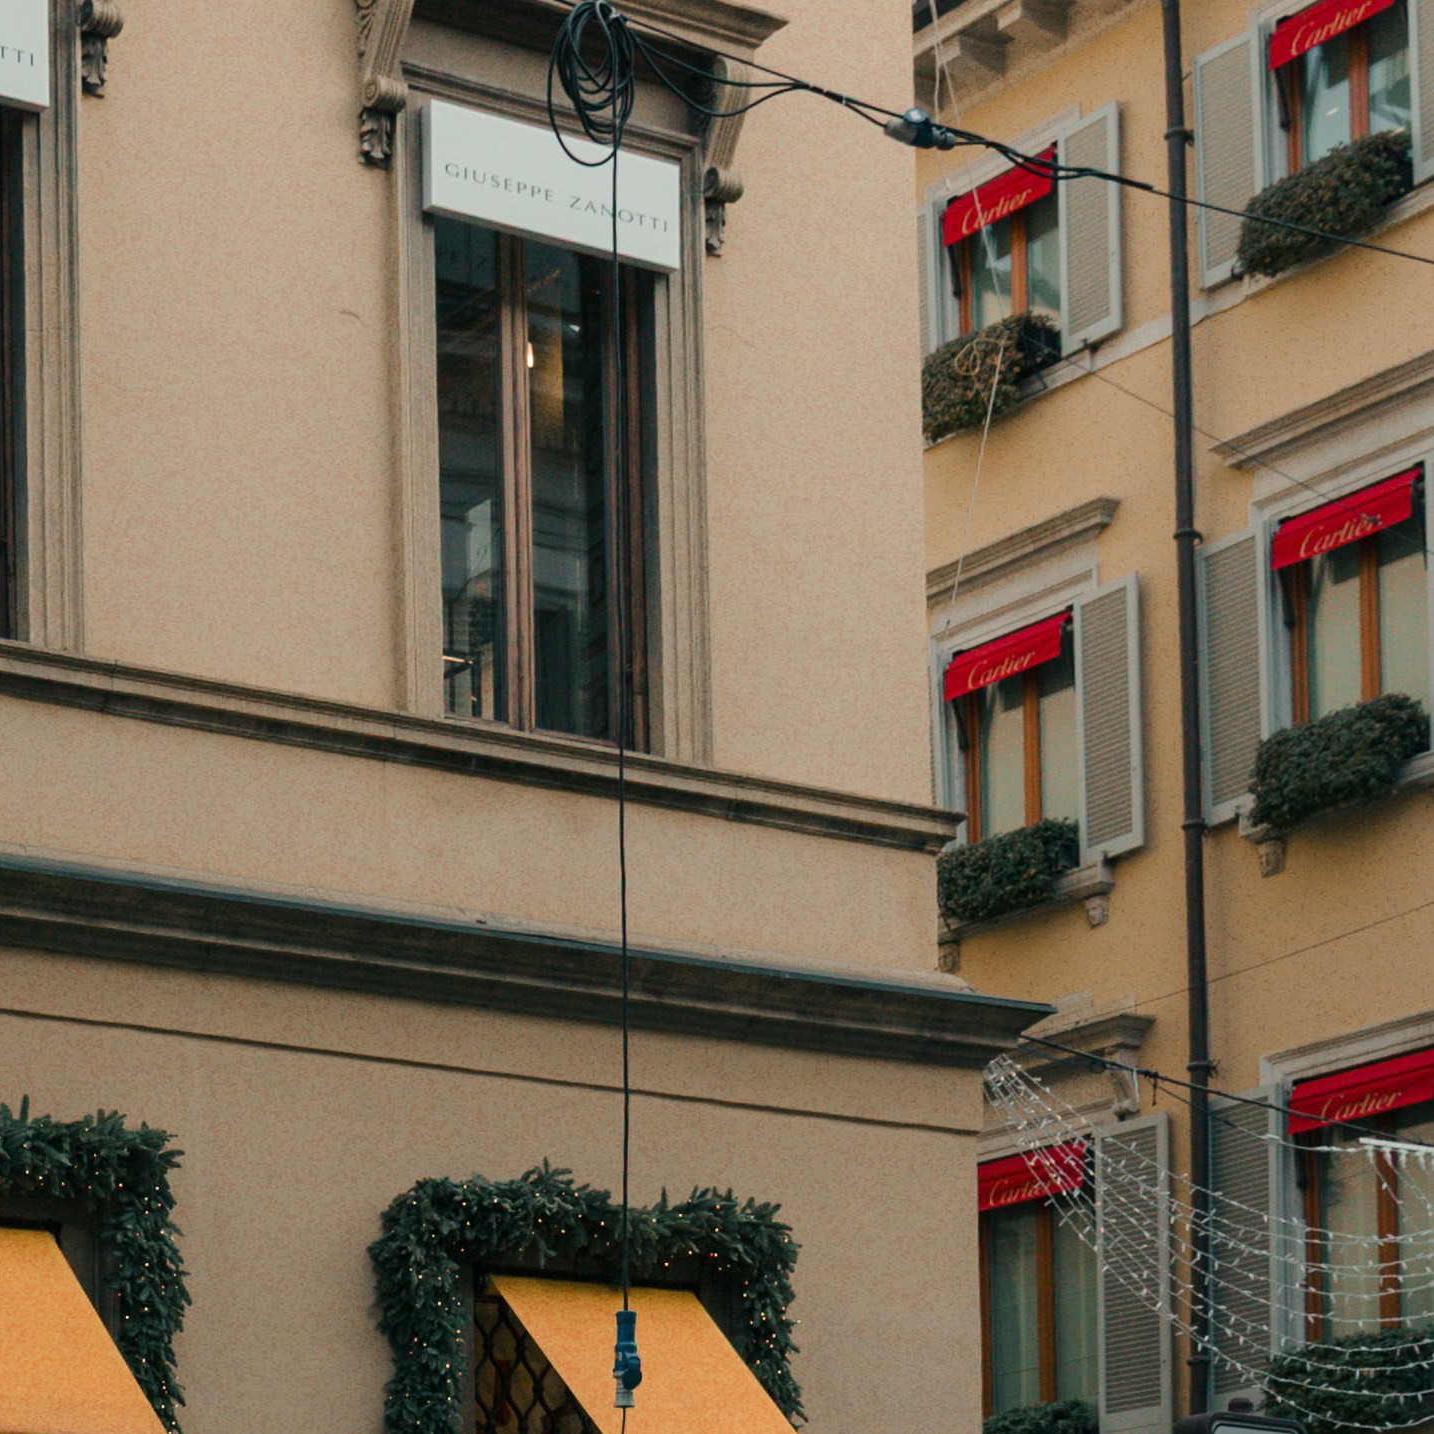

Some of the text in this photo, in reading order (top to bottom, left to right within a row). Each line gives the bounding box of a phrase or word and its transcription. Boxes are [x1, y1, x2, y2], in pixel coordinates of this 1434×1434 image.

[1290, 0, 1373, 56] Cartier
[444, 162, 668, 233] GIUSEPPE ZANOTTI
[961, 188, 1033, 235] Cartier
[967, 651, 1036, 690] Cartier
[1321, 1091, 1403, 1123] Cartier
